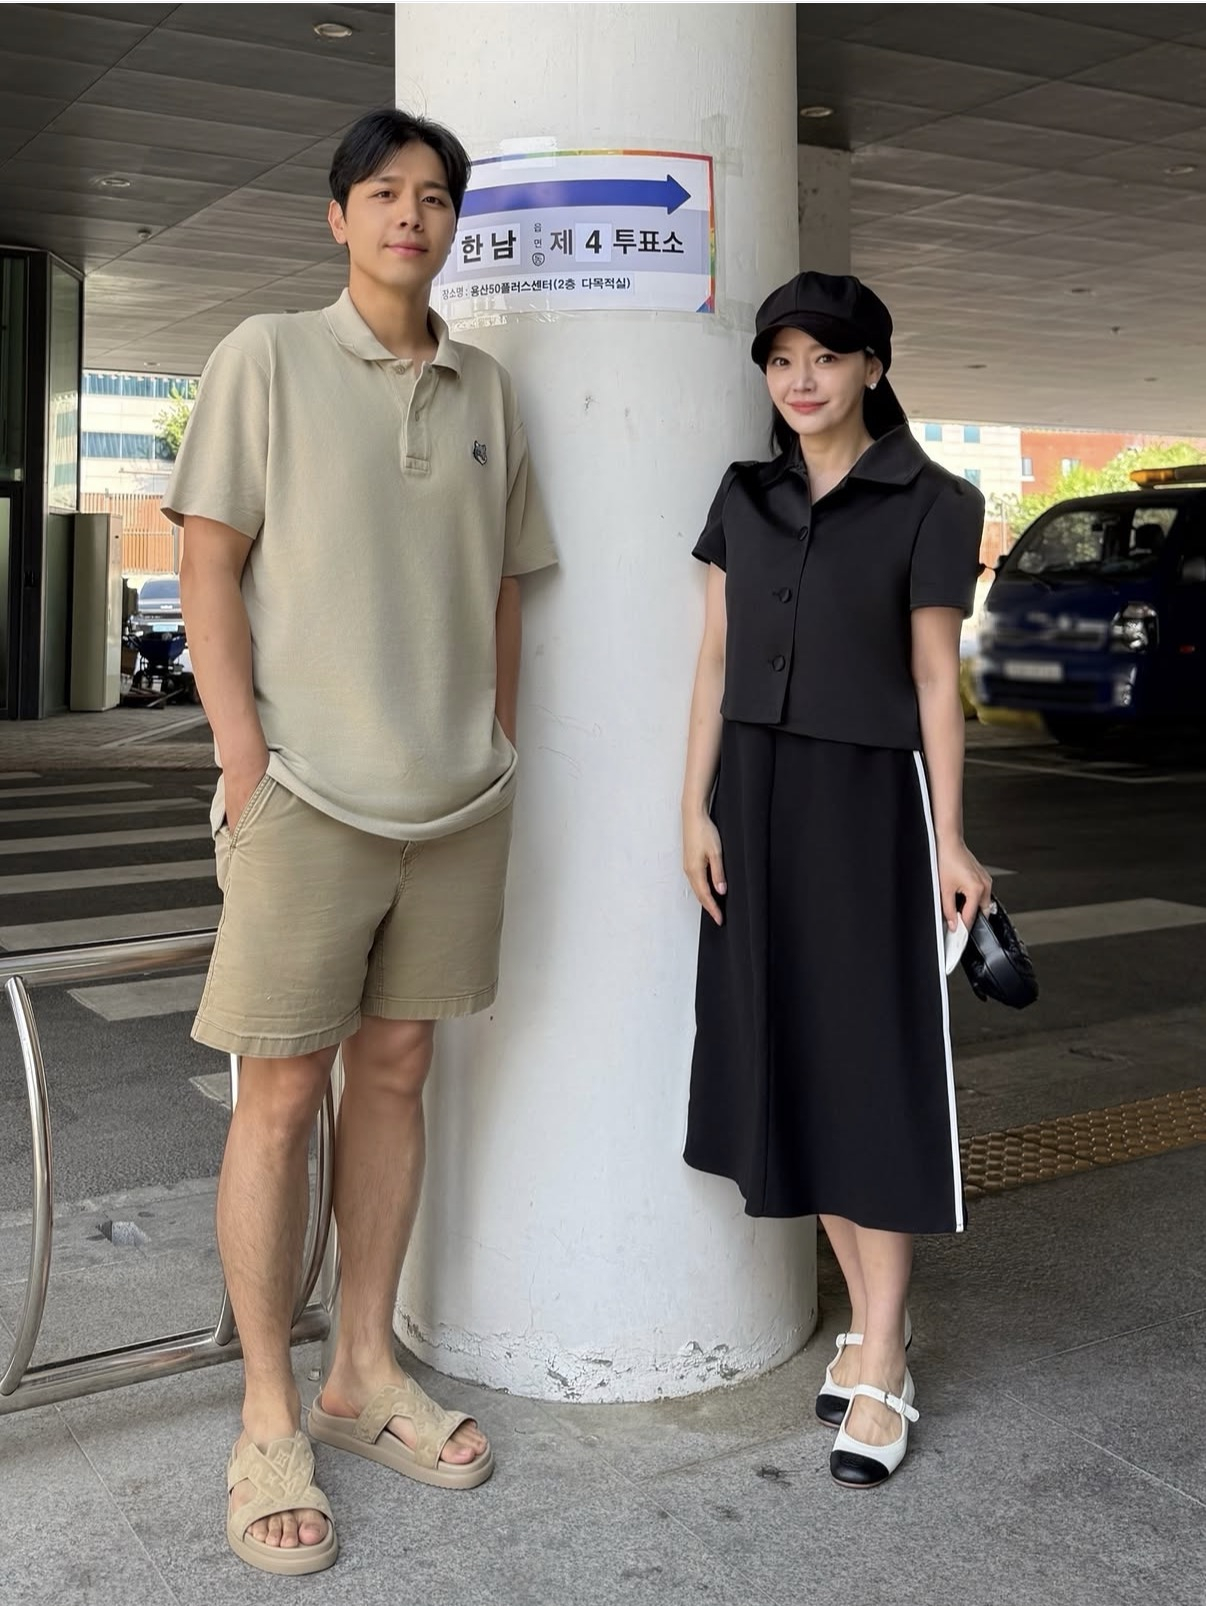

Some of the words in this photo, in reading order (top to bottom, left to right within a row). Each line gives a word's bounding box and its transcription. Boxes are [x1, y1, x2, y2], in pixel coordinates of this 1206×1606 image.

[550, 228, 573, 255] 제
[585, 229, 602, 254] 4
[613, 229, 684, 254] 투표소
